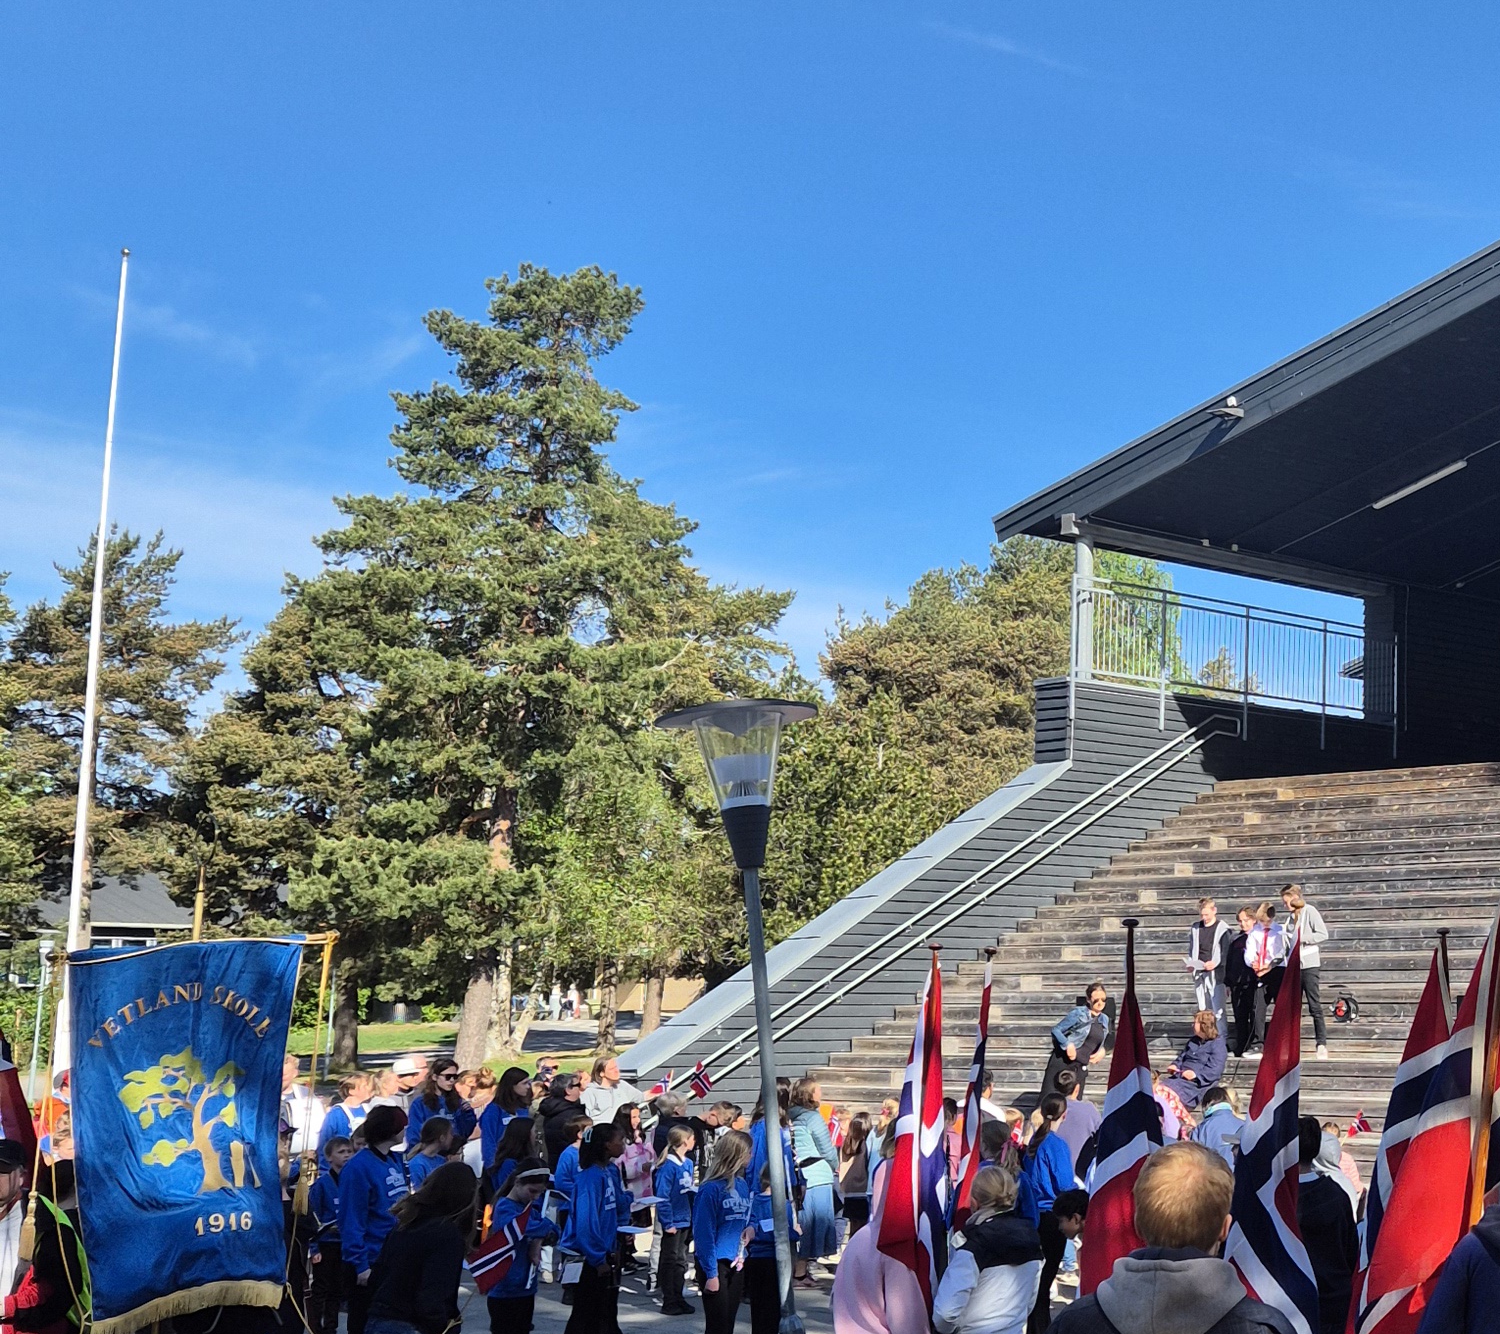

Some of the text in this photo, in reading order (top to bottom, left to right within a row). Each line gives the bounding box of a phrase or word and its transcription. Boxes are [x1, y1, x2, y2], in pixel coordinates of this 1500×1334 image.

[87, 982, 271, 1048] VETLAND SKOLE
[194, 1211, 252, 1236] 1916
